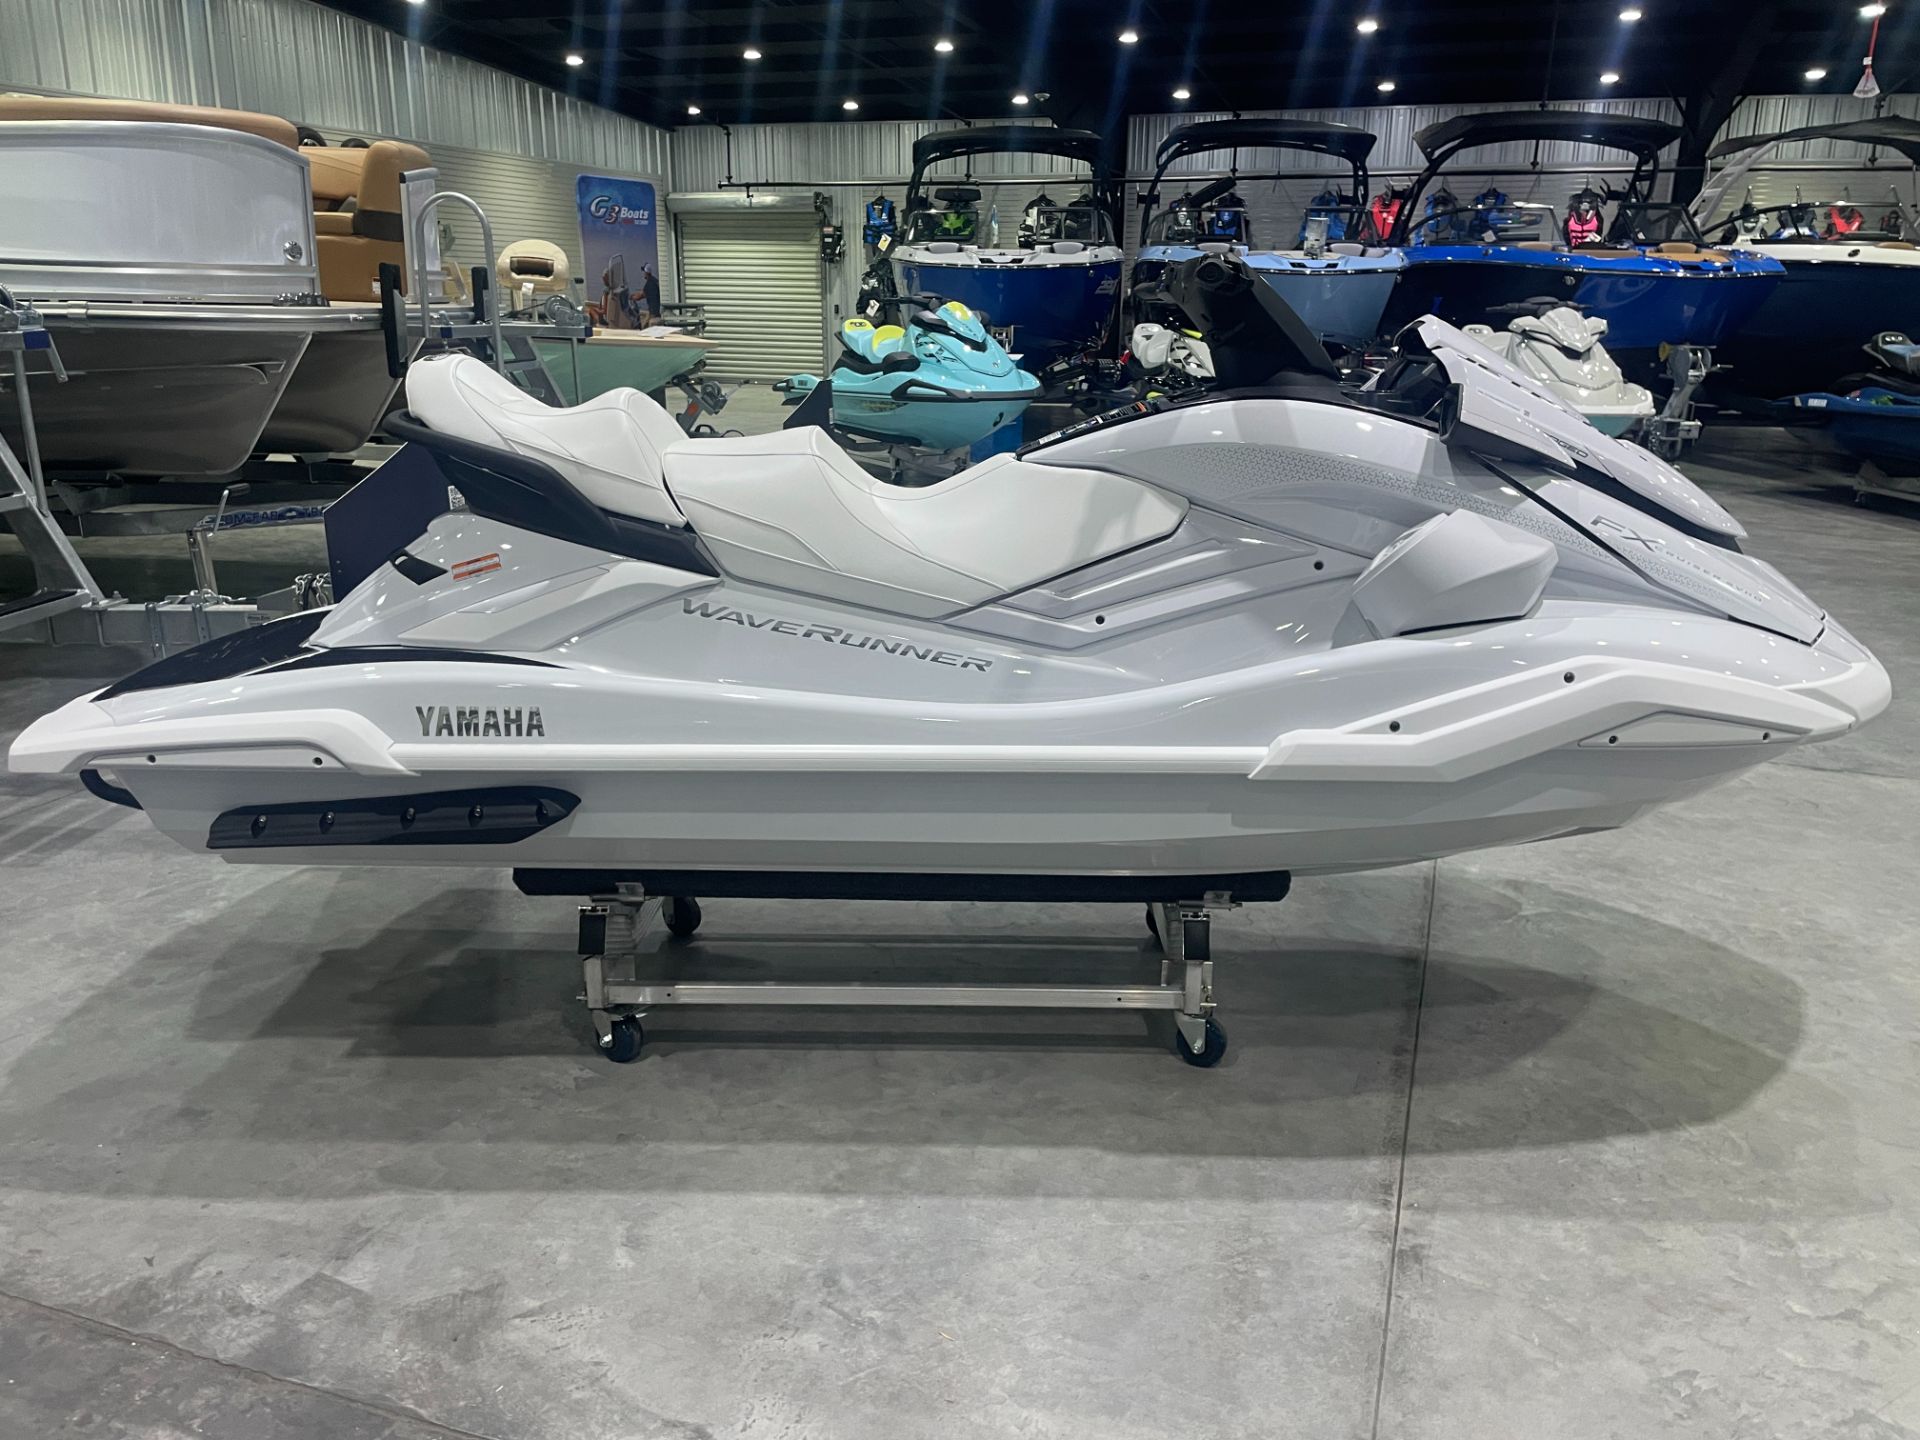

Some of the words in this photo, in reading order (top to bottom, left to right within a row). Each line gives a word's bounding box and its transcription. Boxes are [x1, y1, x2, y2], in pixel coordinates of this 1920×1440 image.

[590, 196, 620, 224] G3
[620, 207, 649, 219] Boats
[1590, 515, 1666, 553] FX
[682, 597, 993, 672] WAVERUNNER
[415, 706, 545, 737] YAMAHA
